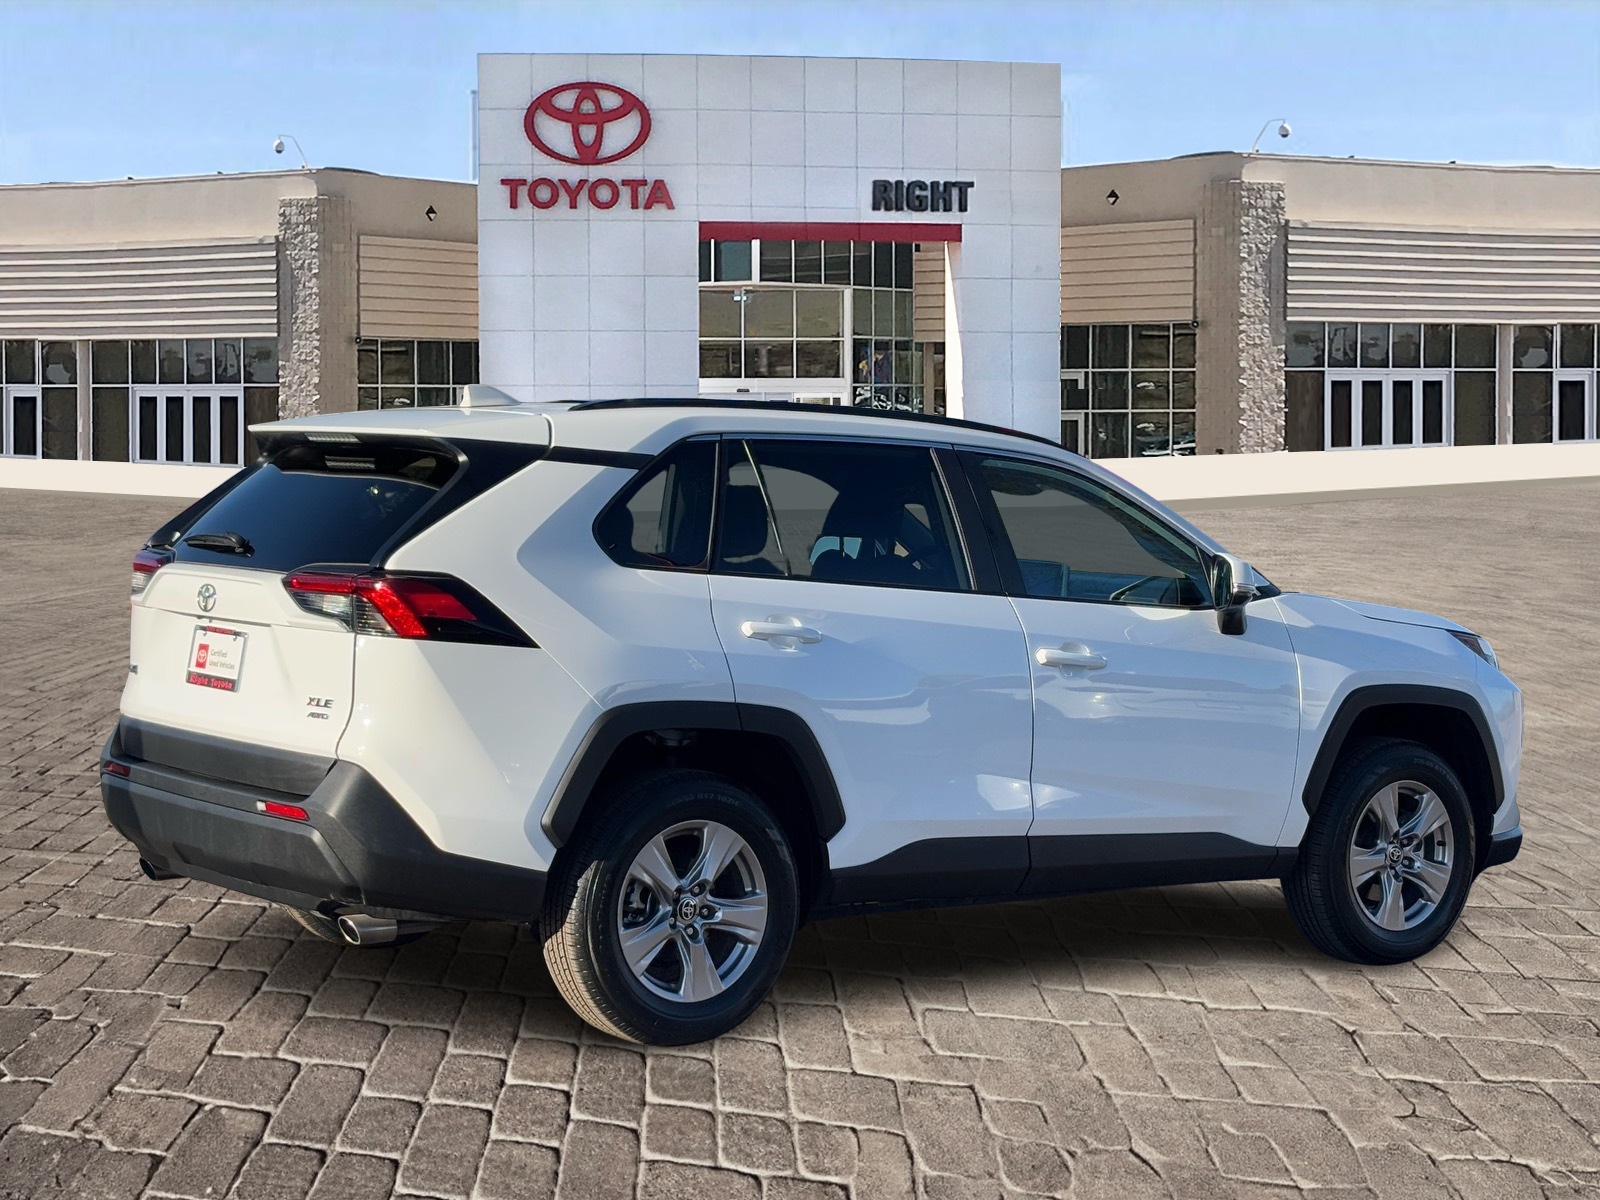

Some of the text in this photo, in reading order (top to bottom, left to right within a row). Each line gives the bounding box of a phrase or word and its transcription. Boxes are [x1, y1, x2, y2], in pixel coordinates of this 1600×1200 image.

[500, 177, 675, 209] TOYOTA
[872, 179, 975, 212] RIGHT
[190, 673, 233, 690] Right Toyota
[306, 697, 334, 708] XLE
